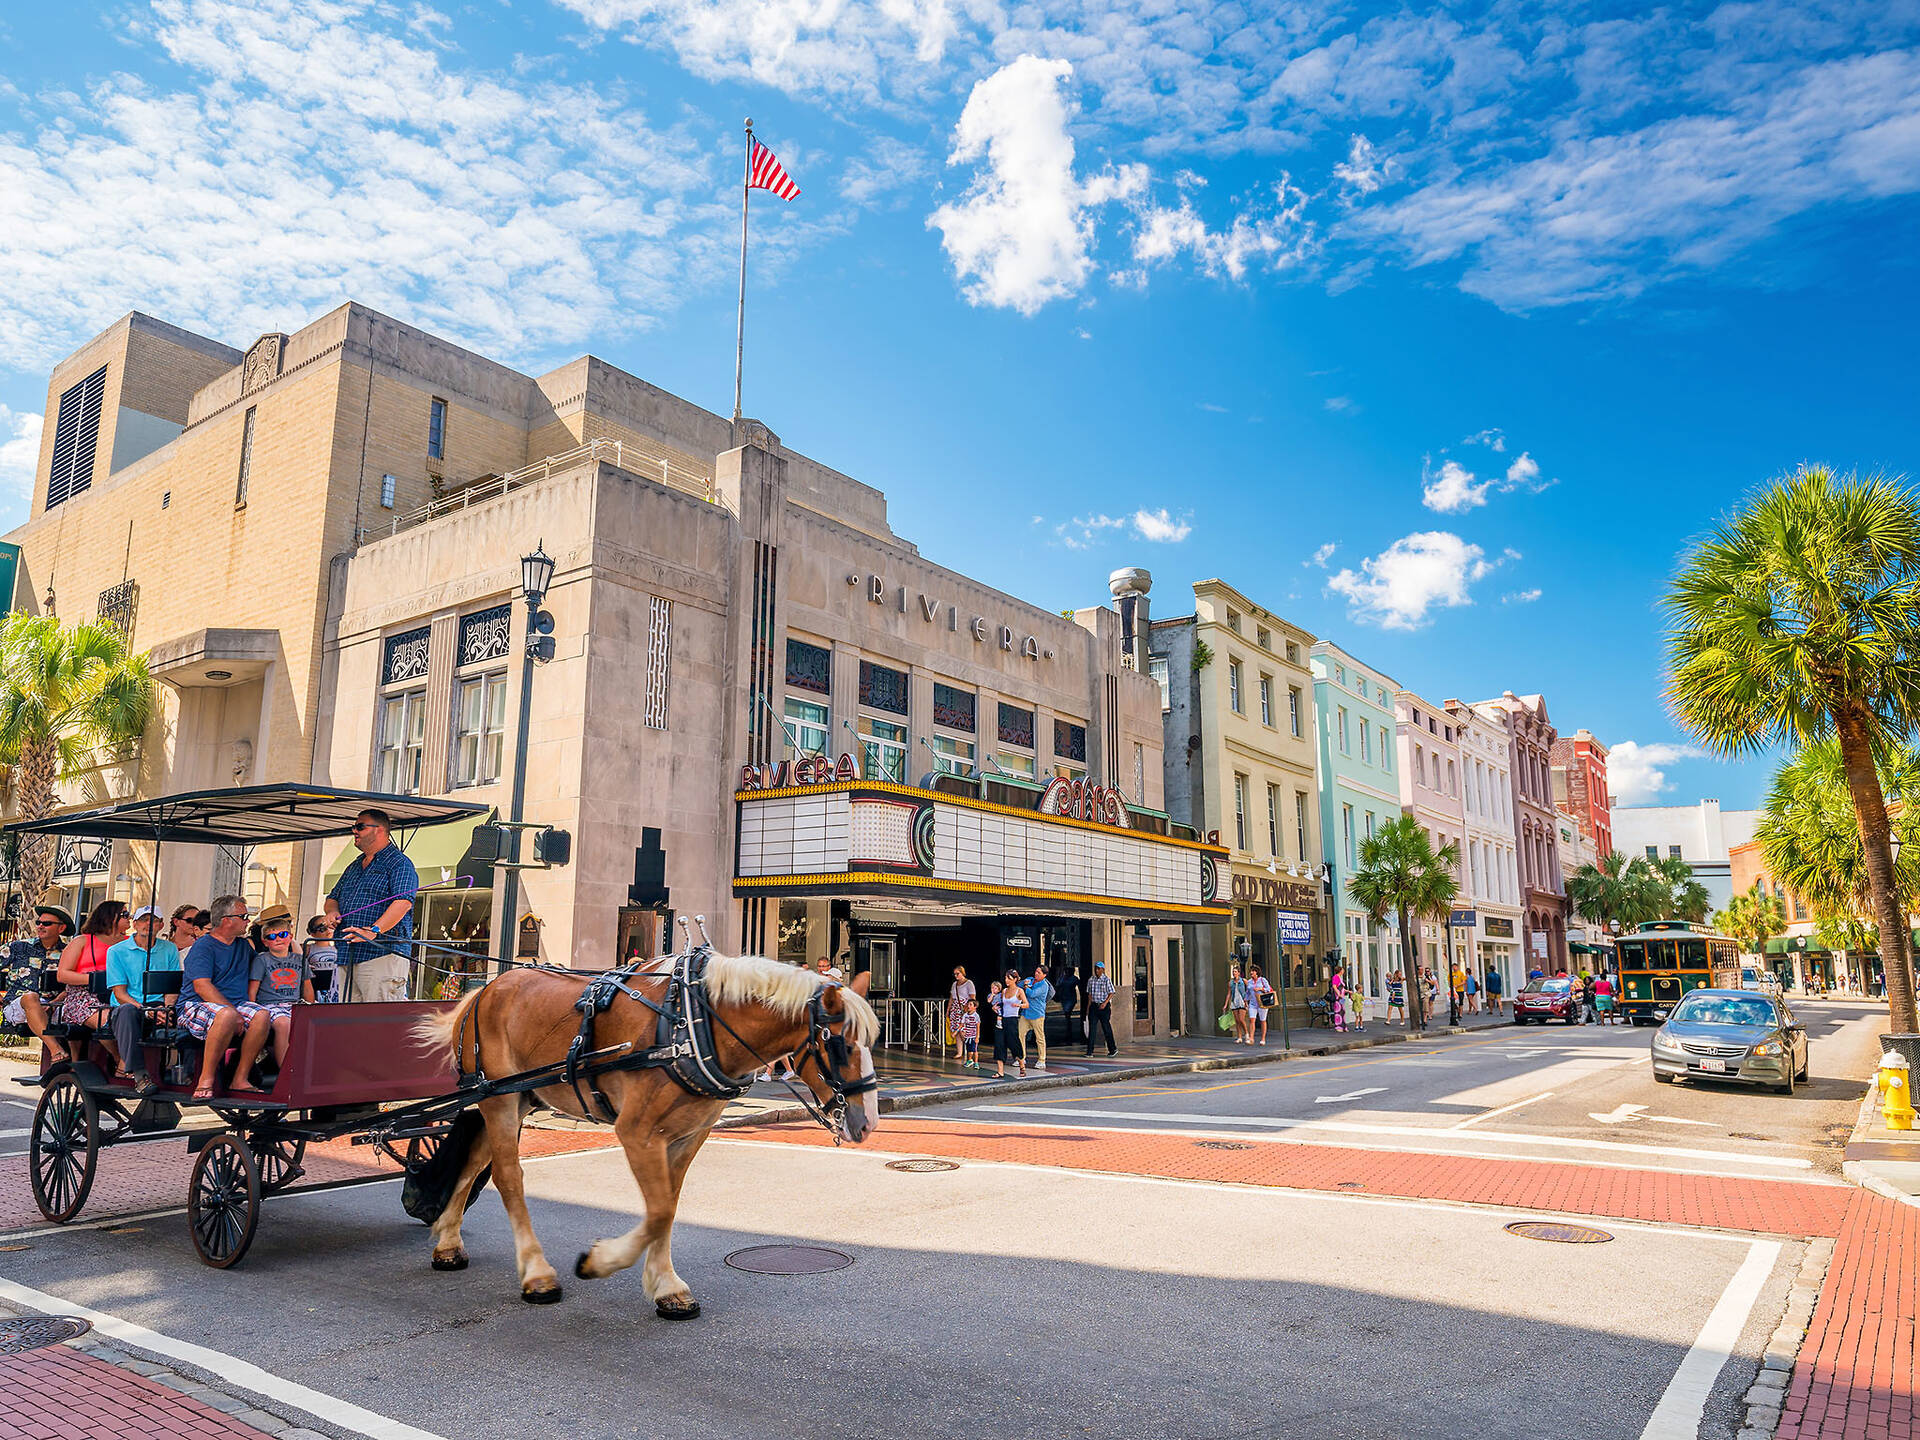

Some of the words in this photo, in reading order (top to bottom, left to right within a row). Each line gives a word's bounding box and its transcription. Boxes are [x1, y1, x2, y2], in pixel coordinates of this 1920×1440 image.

[868, 574, 1039, 662] RIVIERA
[741, 752, 860, 791] RIVIERA
[1232, 874, 1258, 900] OLD
[1259, 878, 1299, 908] TOWNE
